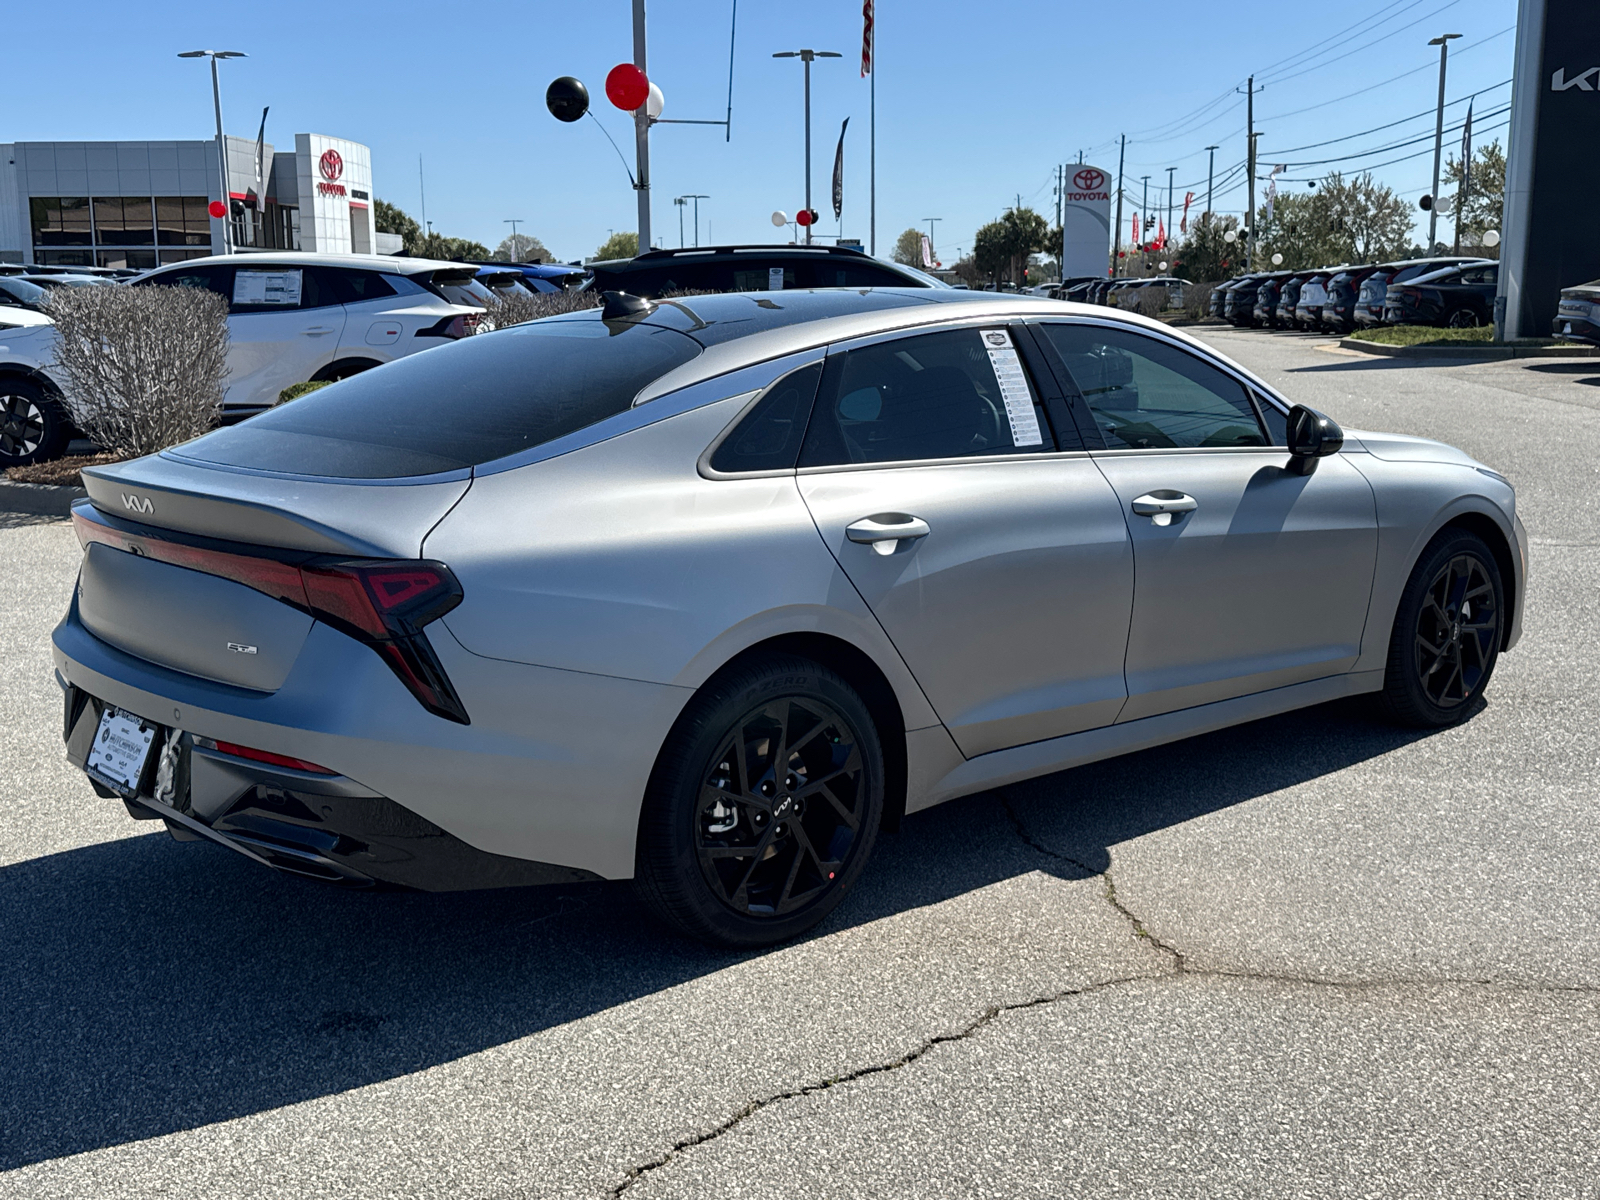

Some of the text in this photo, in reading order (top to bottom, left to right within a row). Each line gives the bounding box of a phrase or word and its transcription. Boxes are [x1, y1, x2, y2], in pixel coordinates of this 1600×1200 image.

[318, 182, 347, 197] TOYOTA
[1067, 192, 1109, 201] TOYOTA
[121, 492, 155, 515] KIA
[759, 676, 808, 692] ZERO
